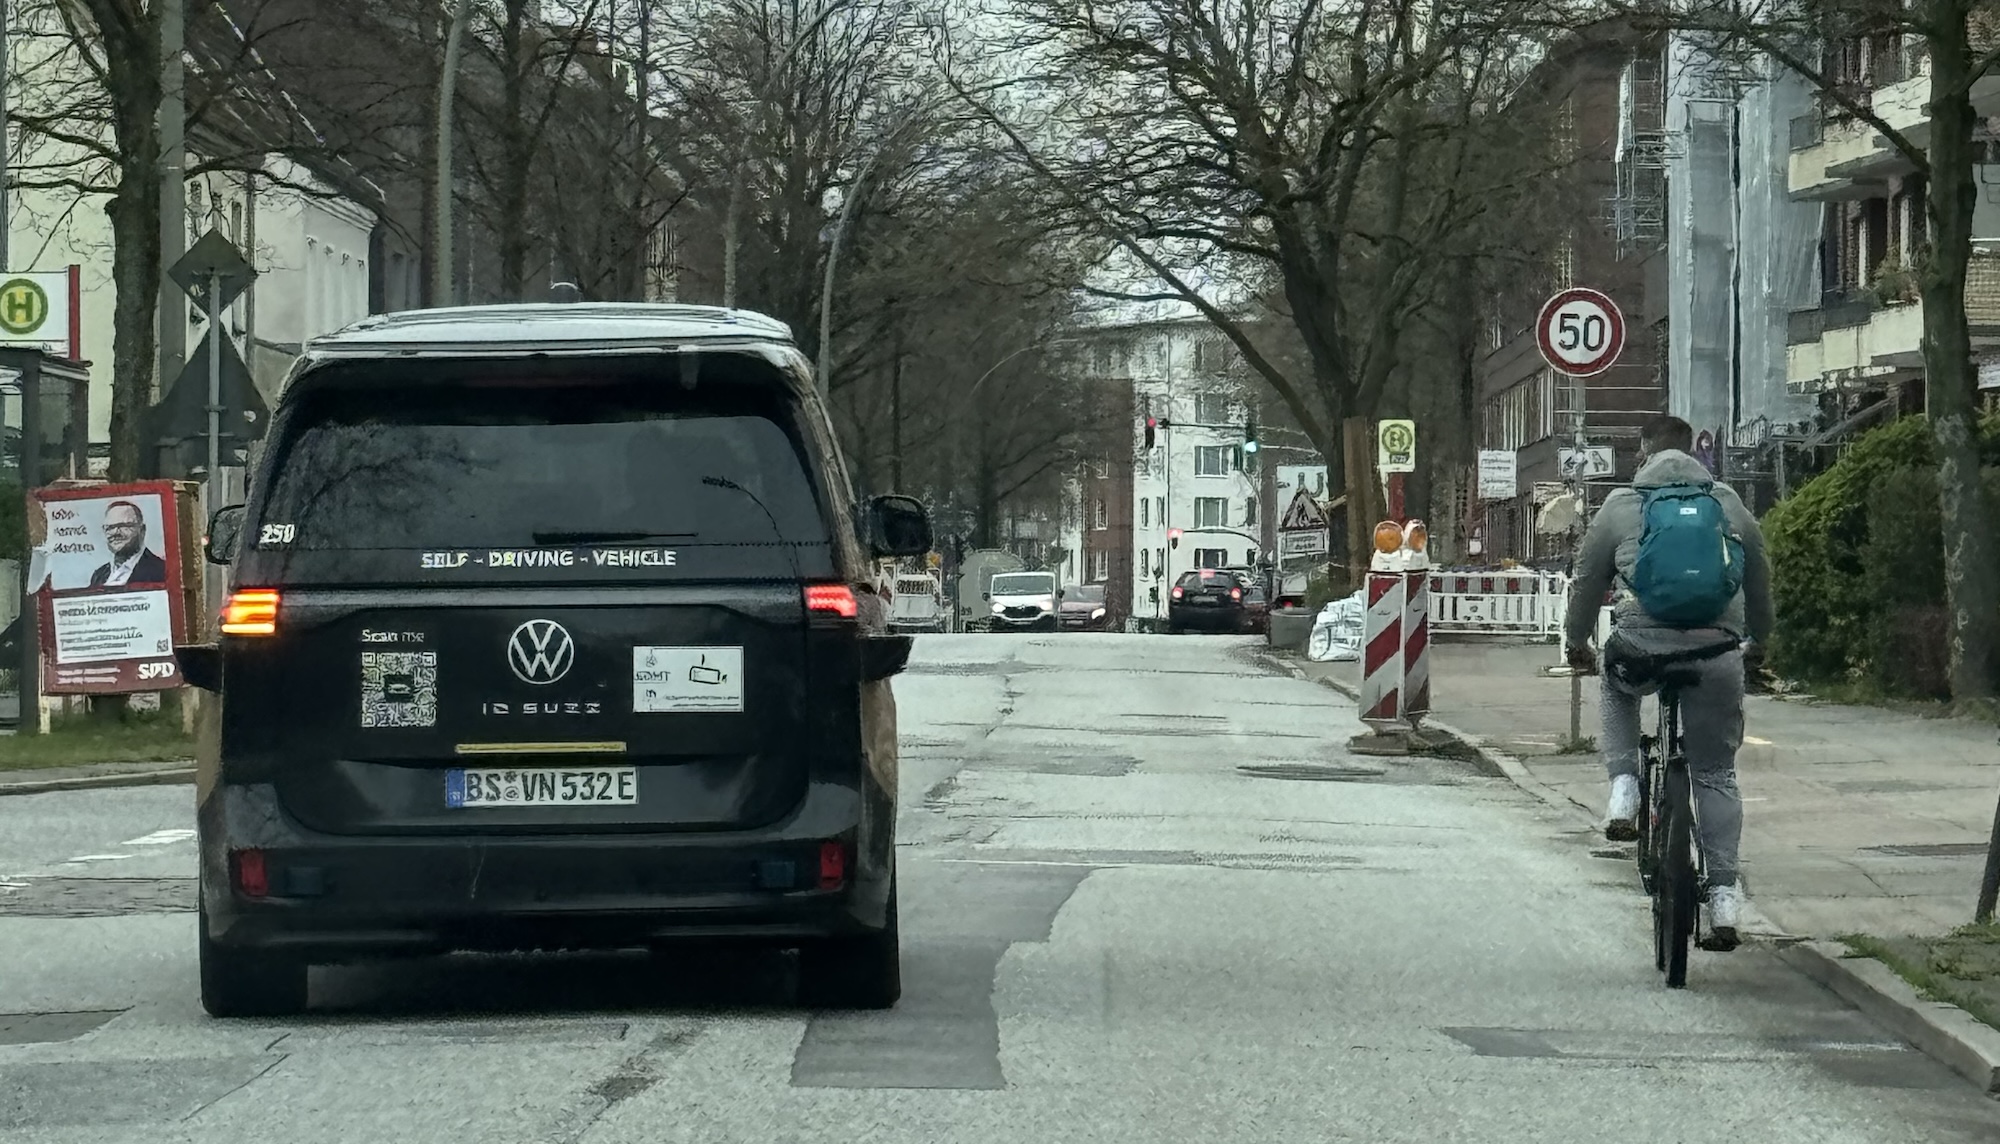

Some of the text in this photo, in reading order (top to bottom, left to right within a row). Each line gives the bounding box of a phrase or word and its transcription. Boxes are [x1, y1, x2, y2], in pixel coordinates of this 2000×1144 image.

[7, 291, 33, 322] H
[1559, 313, 1605, 351] 50
[489, 550, 574, 567] DRIVING
[592, 549, 676, 567] VEHICLE
[508, 619, 574, 684] VW
[138, 662, 176, 680] SPD
[466, 772, 501, 801] BS
[521, 772, 556, 801] VN
[561, 771, 635, 801] 532E
